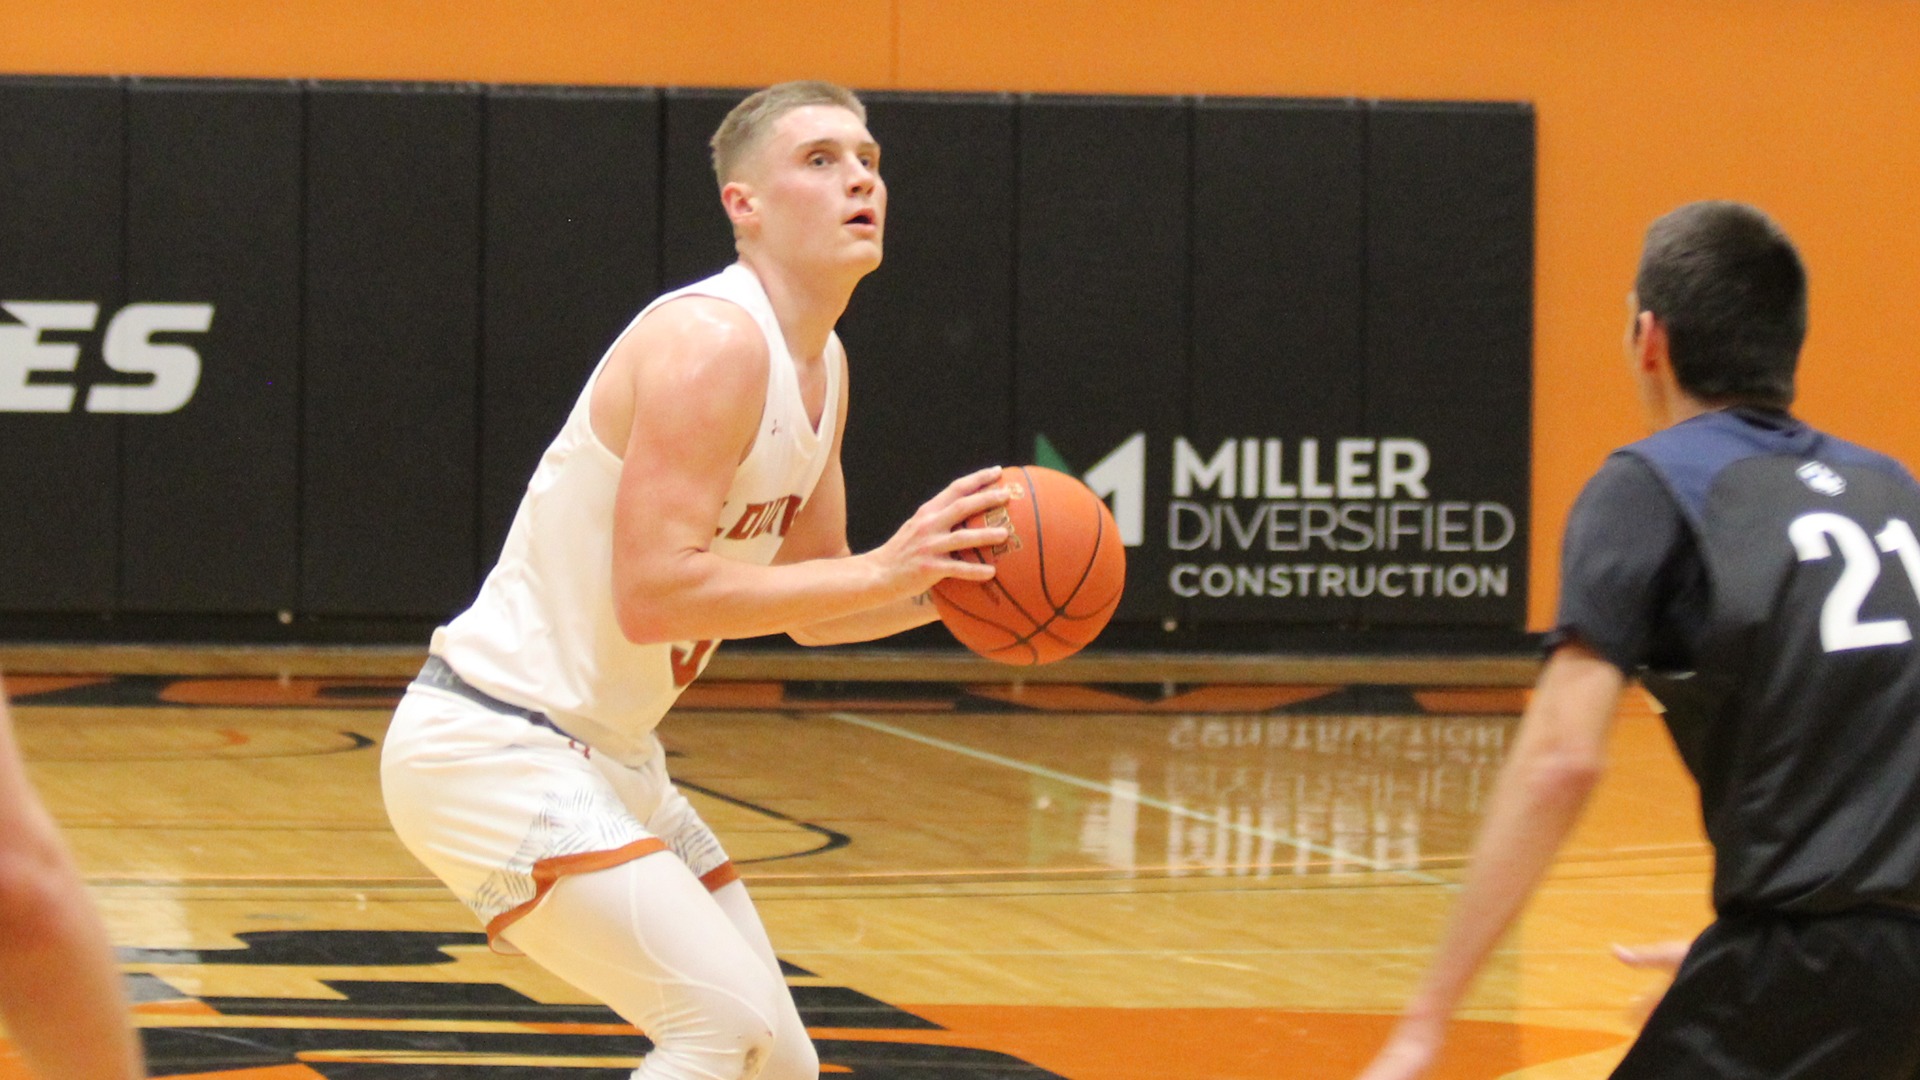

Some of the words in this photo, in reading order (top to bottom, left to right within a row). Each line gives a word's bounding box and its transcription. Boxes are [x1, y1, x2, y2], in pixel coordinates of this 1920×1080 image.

[1172, 437, 1431, 499] MILLER
[1168, 502, 1516, 552] DIVERSIFIED
[1169, 564, 1509, 598] CONSTRUCTION
[1788, 512, 1920, 653] 21
